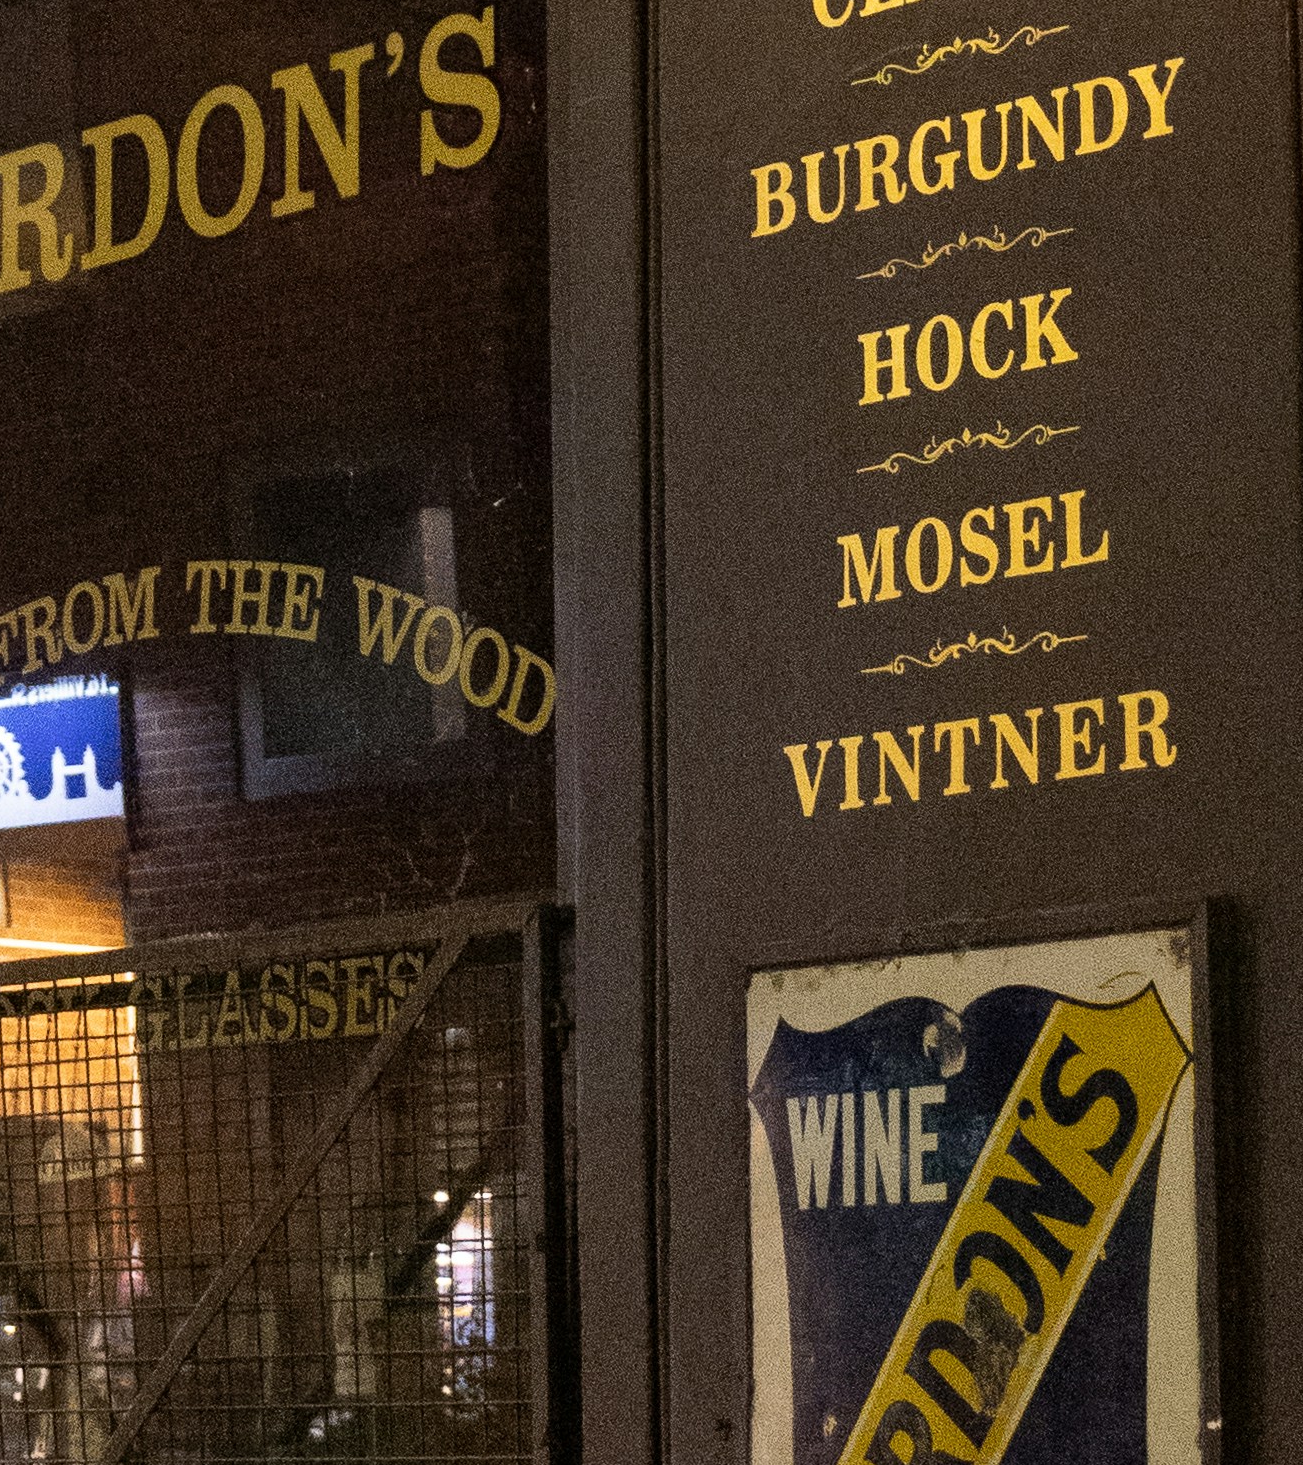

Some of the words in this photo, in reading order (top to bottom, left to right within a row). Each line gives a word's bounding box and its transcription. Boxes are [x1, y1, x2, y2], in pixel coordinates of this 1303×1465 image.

[750, 56, 1185, 238] BURGUNDY
[857, 287, 1079, 406] HOCK
[836, 489, 1109, 609] MOSEL
[185, 559, 326, 642] THE
[353, 575, 558, 737] WOOD
[783, 689, 1178, 818] VINTNER
[786, 1084, 948, 1211] WINE
